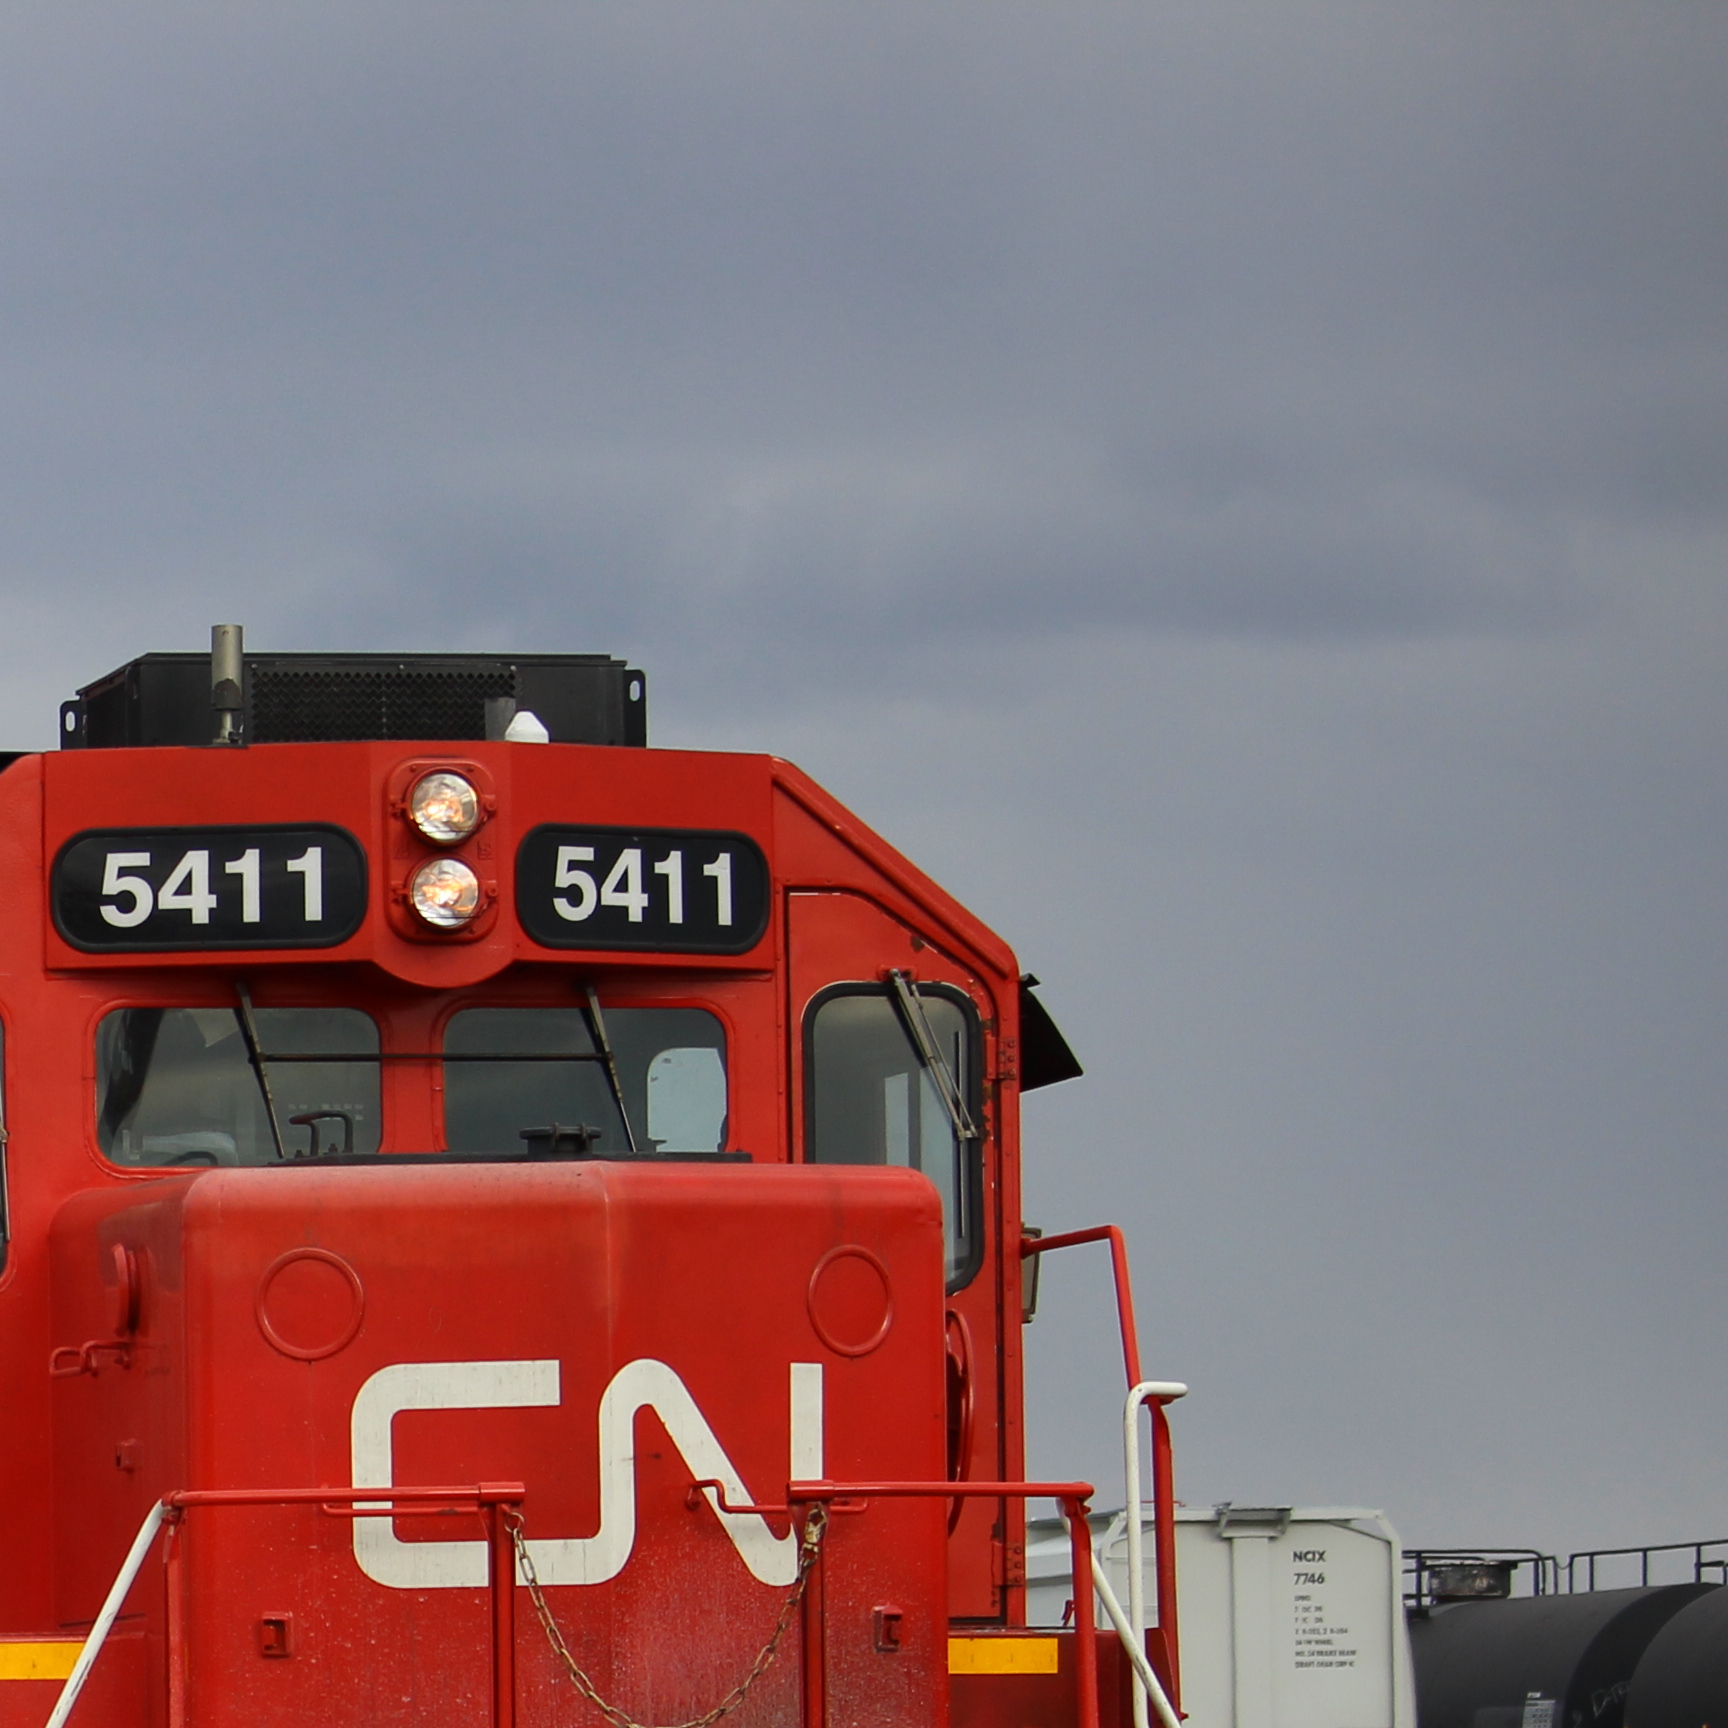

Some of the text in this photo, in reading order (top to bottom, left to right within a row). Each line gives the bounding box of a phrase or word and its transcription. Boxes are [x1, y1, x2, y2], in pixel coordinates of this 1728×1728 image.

[99, 846, 322, 928] 5411
[553, 845, 732, 926] 5411
[351, 1358, 823, 1588] CN
[1292, 1550, 1326, 1562] NCIX
[1293, 1572, 1325, 1585] 7746
